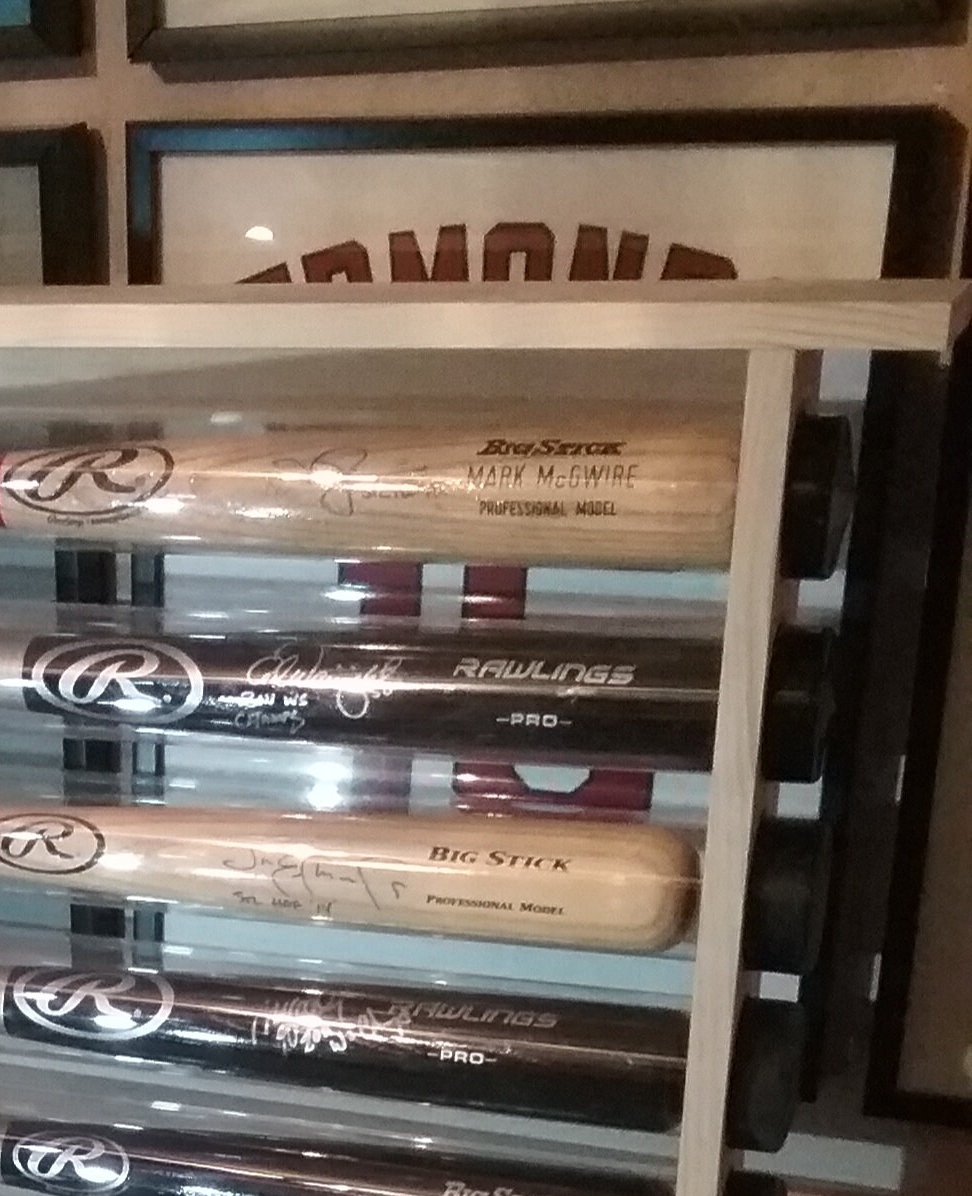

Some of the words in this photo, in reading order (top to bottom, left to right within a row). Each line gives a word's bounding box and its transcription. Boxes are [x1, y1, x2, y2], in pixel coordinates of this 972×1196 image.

[467, 463, 526, 490] MARK
[536, 463, 640, 490] McGWIRE
[479, 500, 568, 518] PROFESSIONAL
[575, 500, 618, 517] MODEL
[452, 656, 638, 686] RAWLINGS
[428, 845, 478, 864] BIG
[485, 849, 571, 872] STICK
[426, 894, 513, 912] PROFESSIONAL
[519, 901, 565, 916] MODEL
